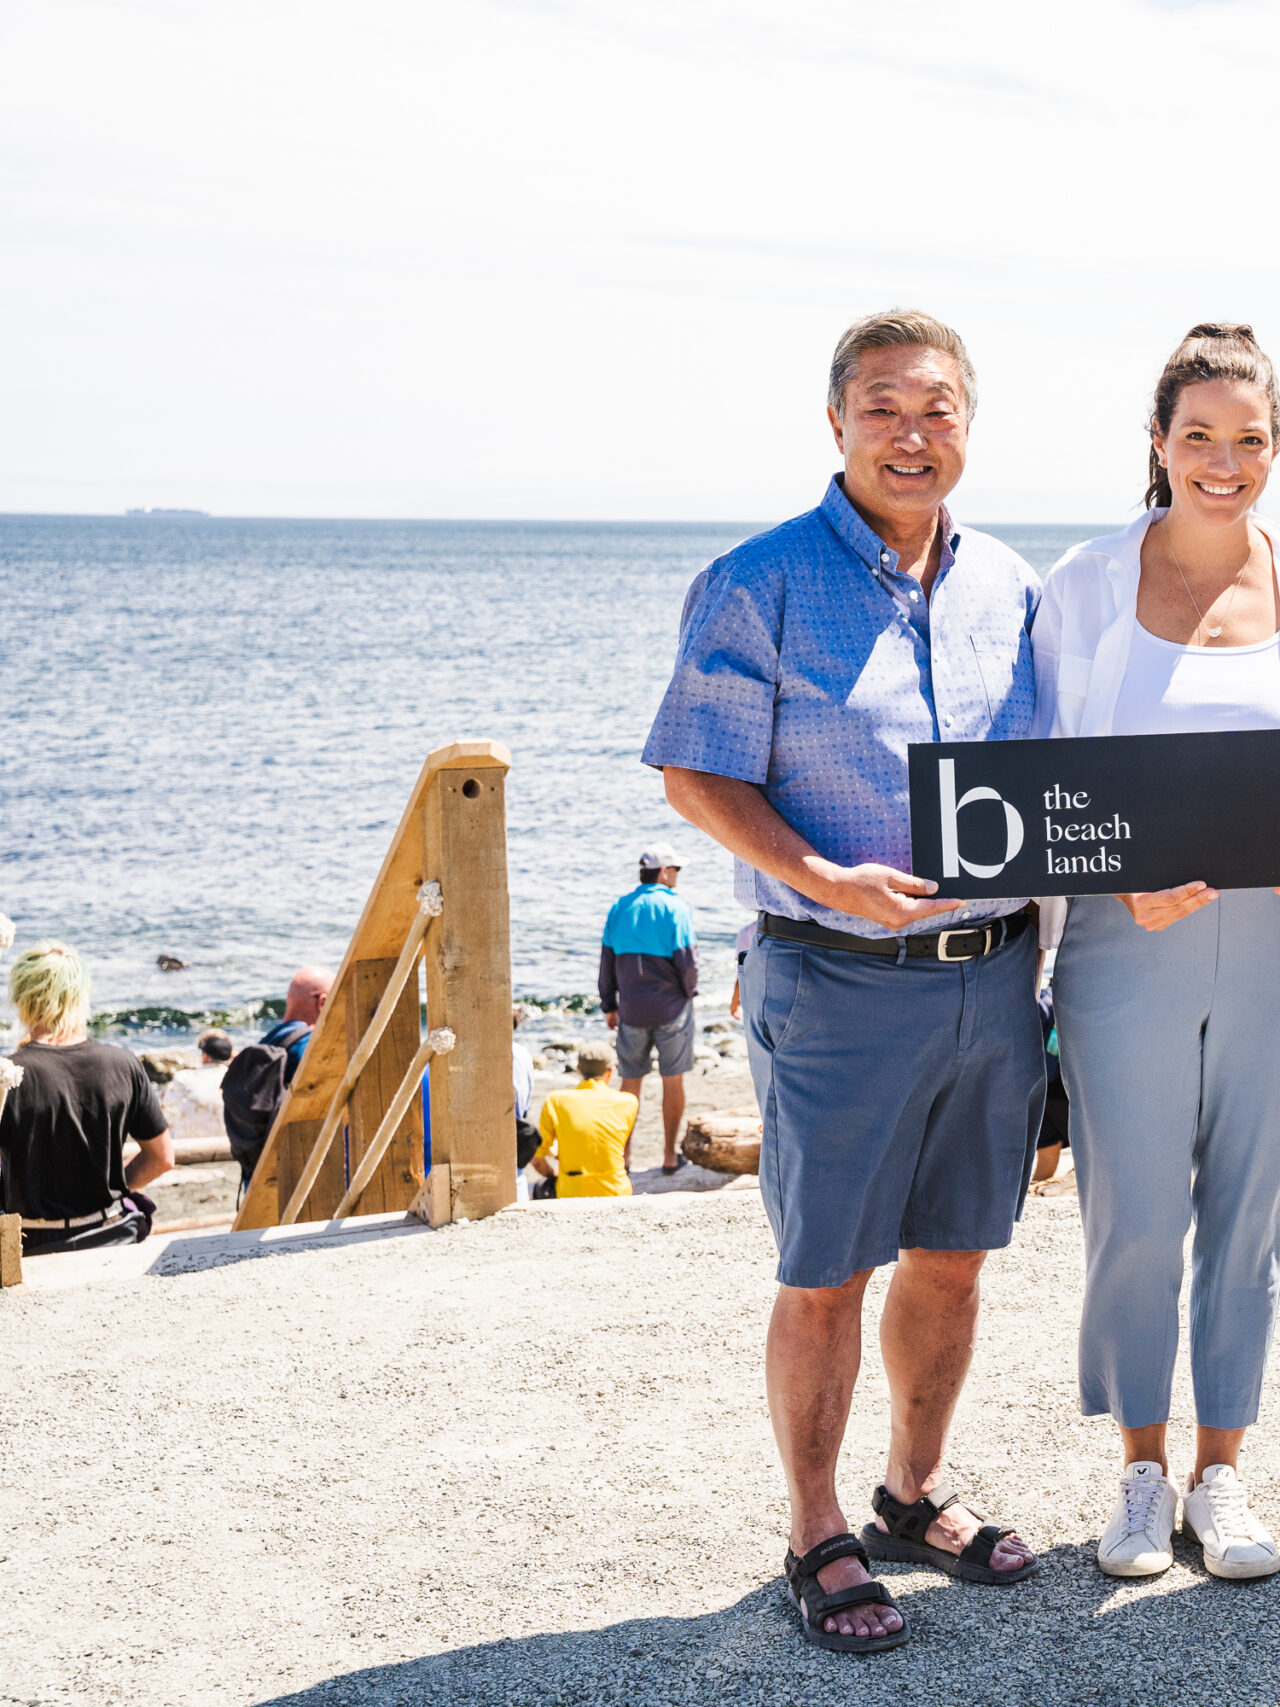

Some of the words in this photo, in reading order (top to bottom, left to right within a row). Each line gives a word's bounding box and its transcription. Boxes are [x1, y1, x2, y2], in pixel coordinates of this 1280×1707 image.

[1043, 783, 1091, 810] the
[938, 758, 1024, 879] b
[1045, 813, 1132, 842] beach
[1046, 846, 1122, 875] lands
